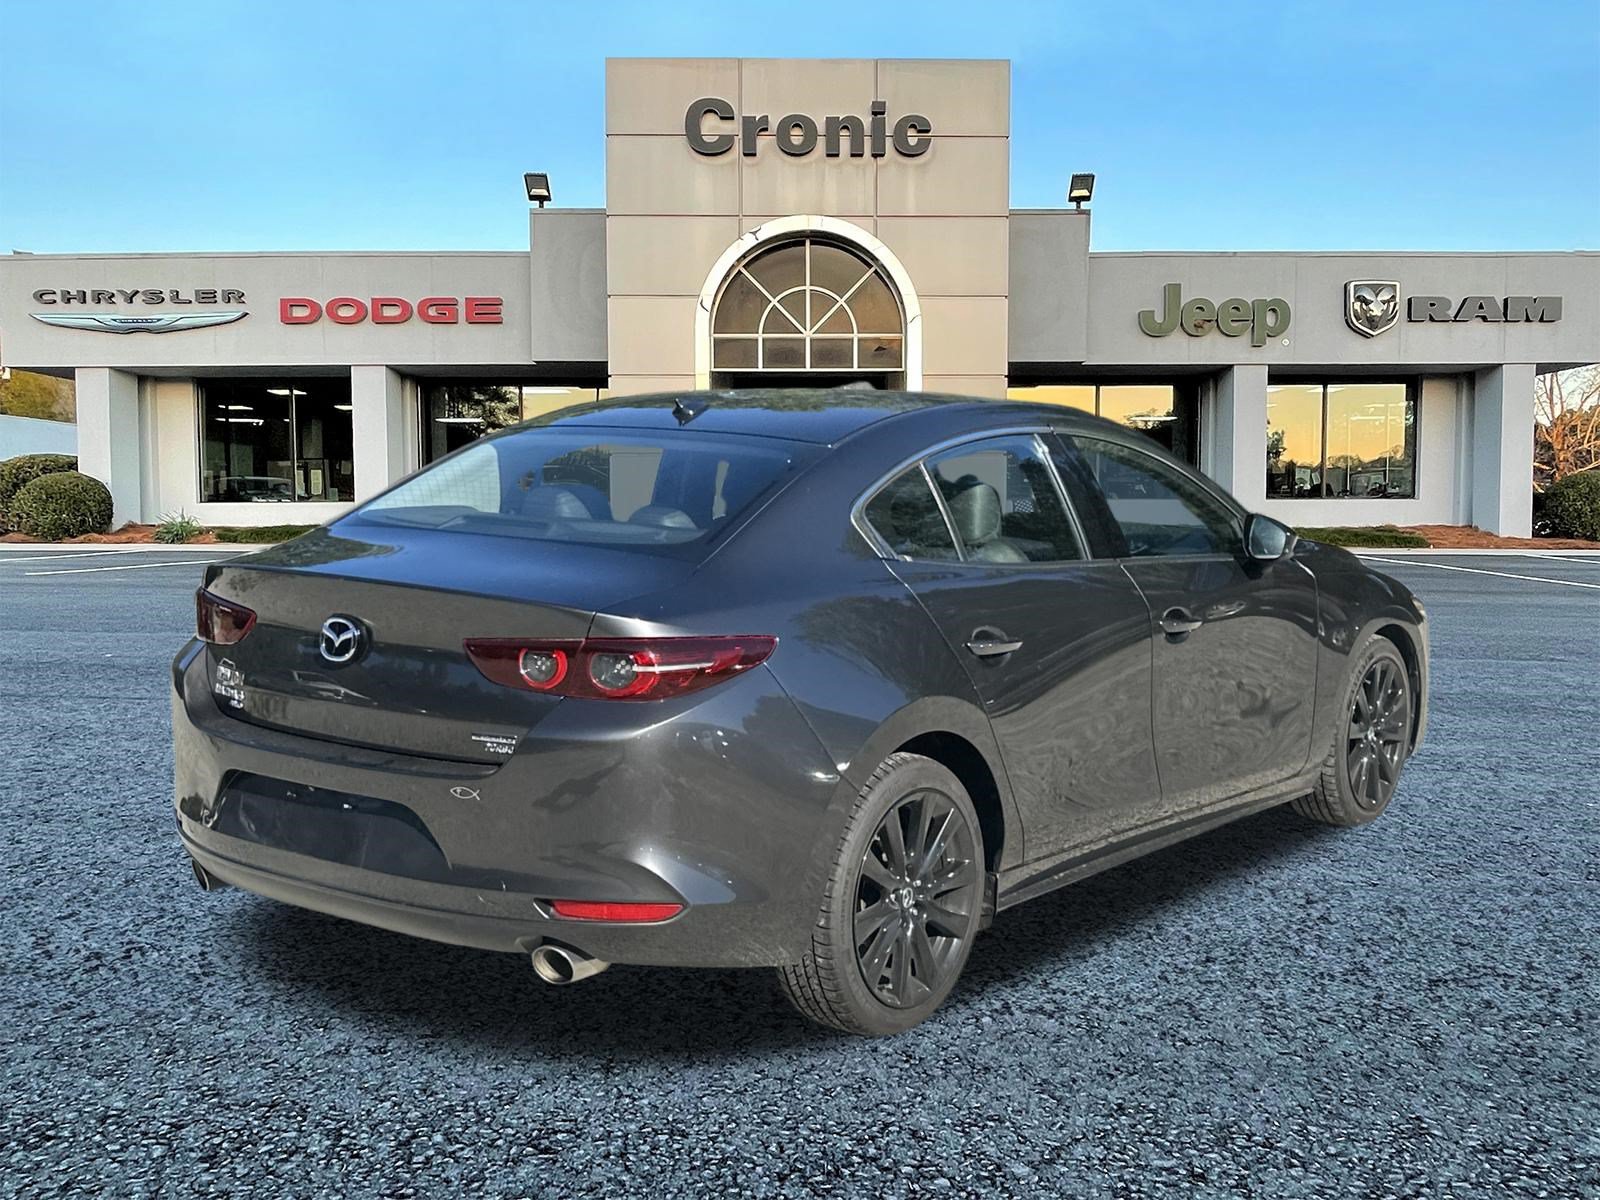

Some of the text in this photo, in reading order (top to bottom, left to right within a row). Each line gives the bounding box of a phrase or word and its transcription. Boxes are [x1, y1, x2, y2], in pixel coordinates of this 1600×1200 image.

[685, 98, 932, 157] Cronic
[32, 288, 247, 305] CHRYSLER
[1407, 296, 1563, 322] RAM
[280, 297, 504, 325] DODGE
[1138, 283, 1291, 347] Jeep
